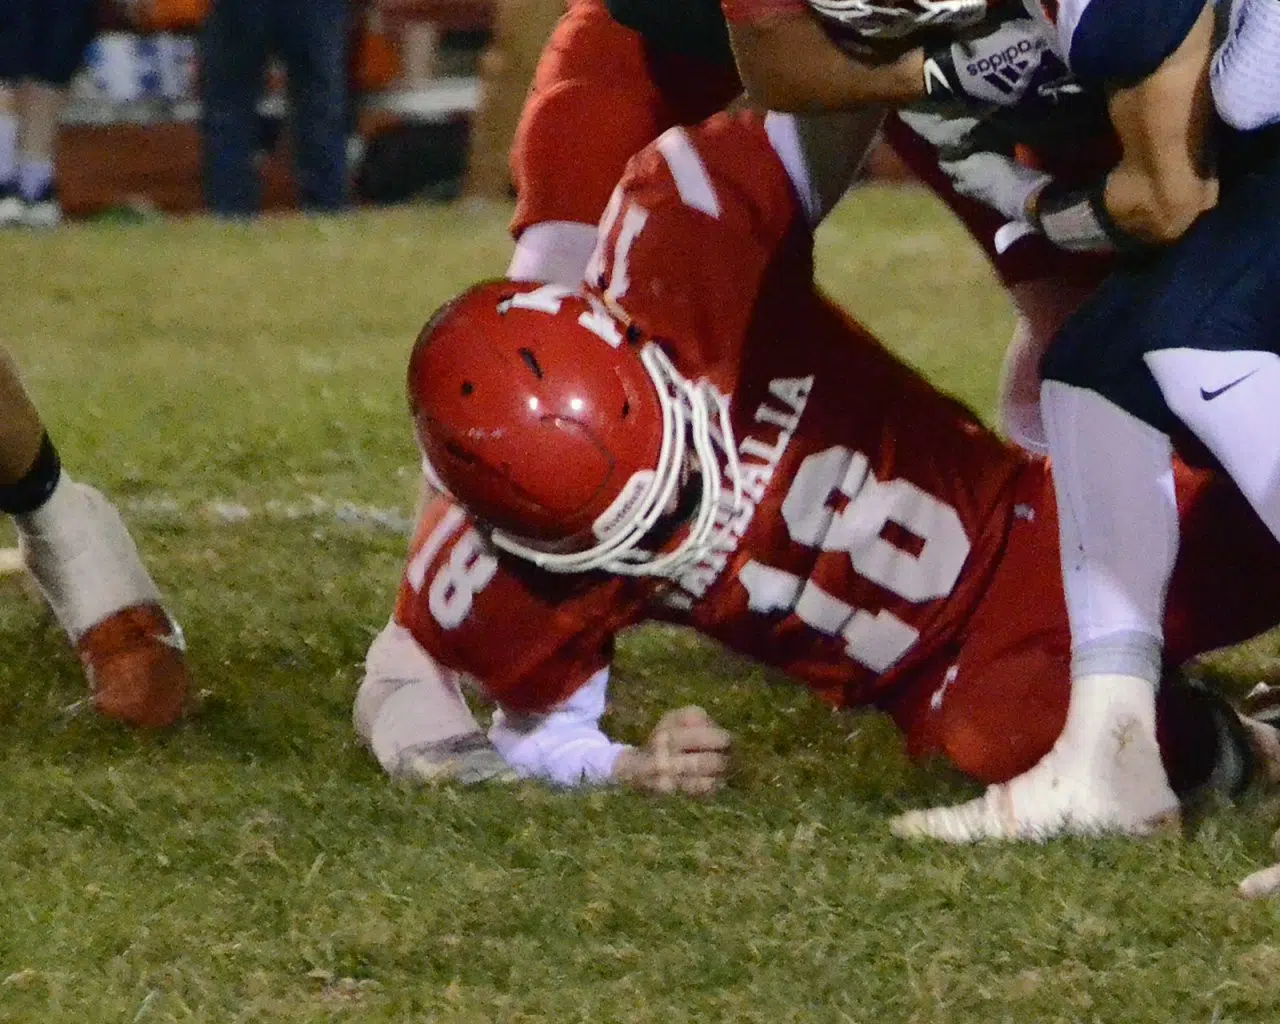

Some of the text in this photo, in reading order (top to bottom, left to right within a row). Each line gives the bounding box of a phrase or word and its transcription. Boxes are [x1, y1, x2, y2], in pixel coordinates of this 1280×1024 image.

[966, 39, 1032, 76] adidas
[407, 503, 499, 630] 18
[738, 444, 970, 674] 18
